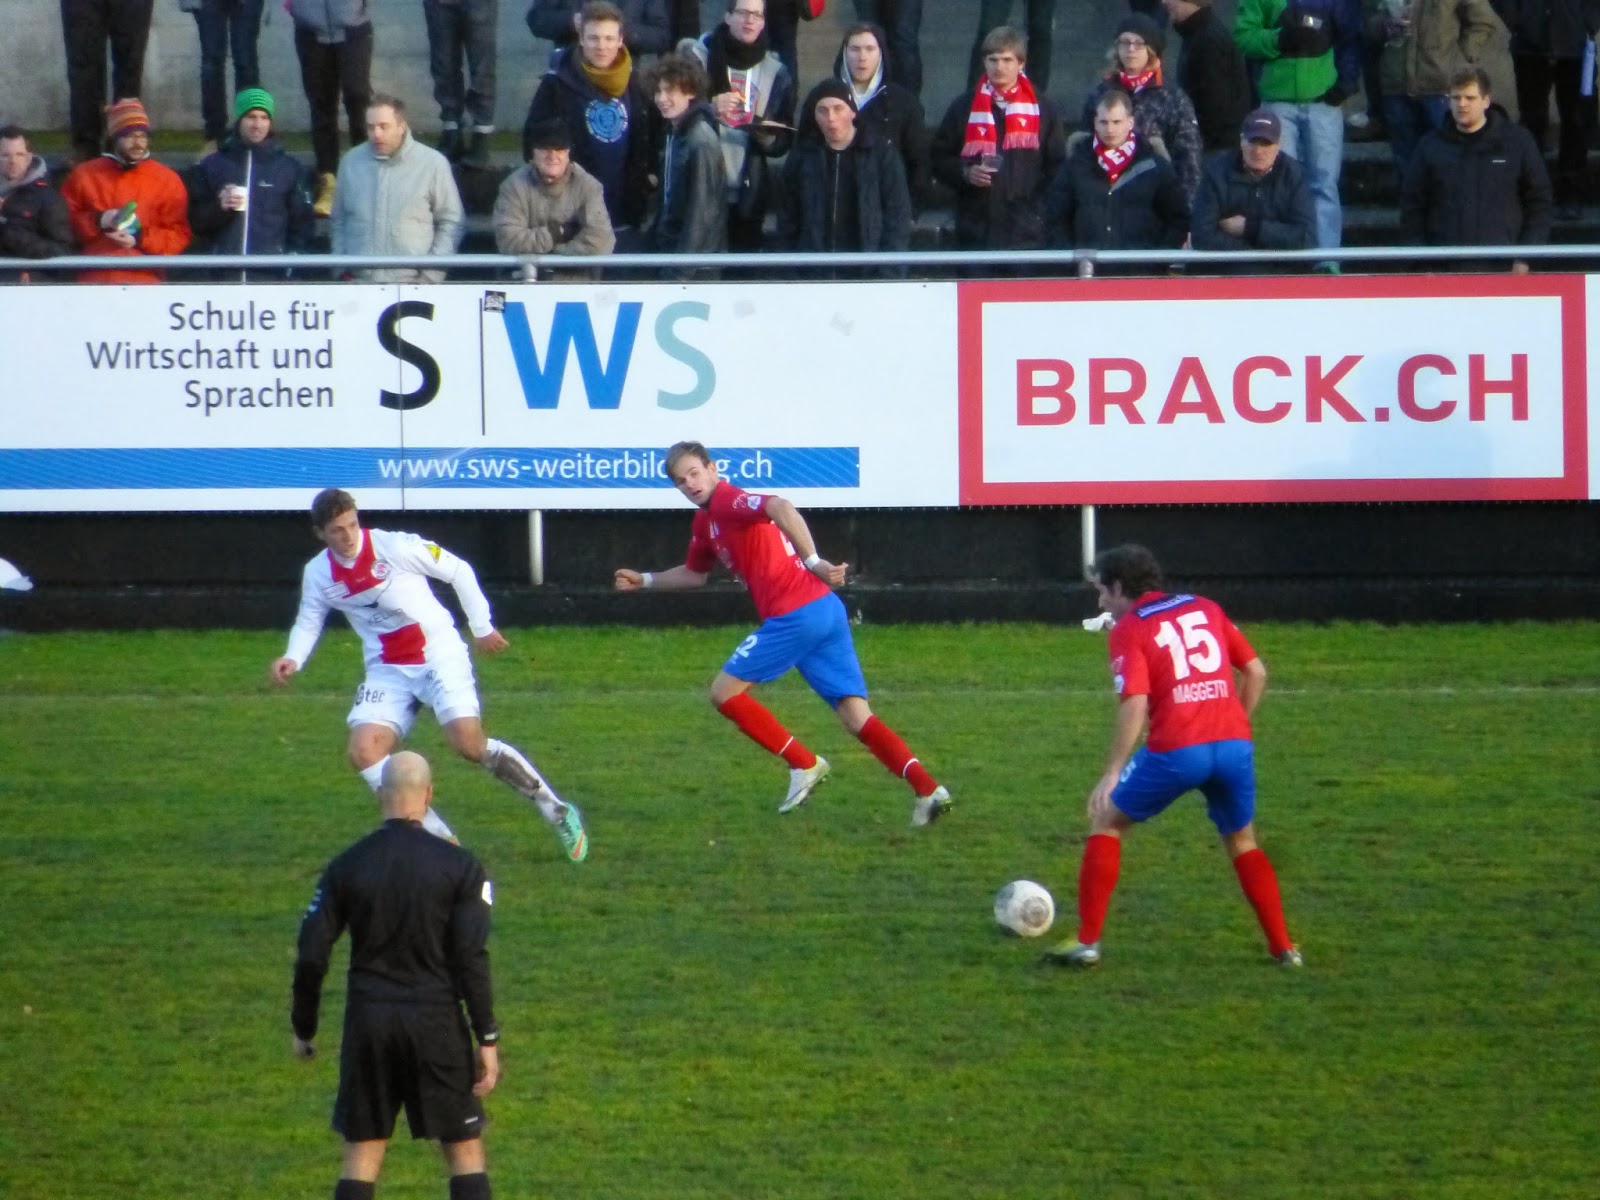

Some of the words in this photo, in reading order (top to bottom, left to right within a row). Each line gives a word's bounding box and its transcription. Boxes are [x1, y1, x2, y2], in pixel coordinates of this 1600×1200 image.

[170, 301, 276, 331] Schule
[287, 299, 335, 331] für
[86, 339, 259, 370] Wirtschaft
[273, 339, 332, 369] und
[185, 378, 333, 417] Sprachen
[1017, 354, 1529, 426] BRACK.CH
[379, 450, 774, 483] www.sws-weiterbilg.ch
[1153, 610, 1222, 681] 15
[1172, 679, 1230, 705] MAGGETTI
